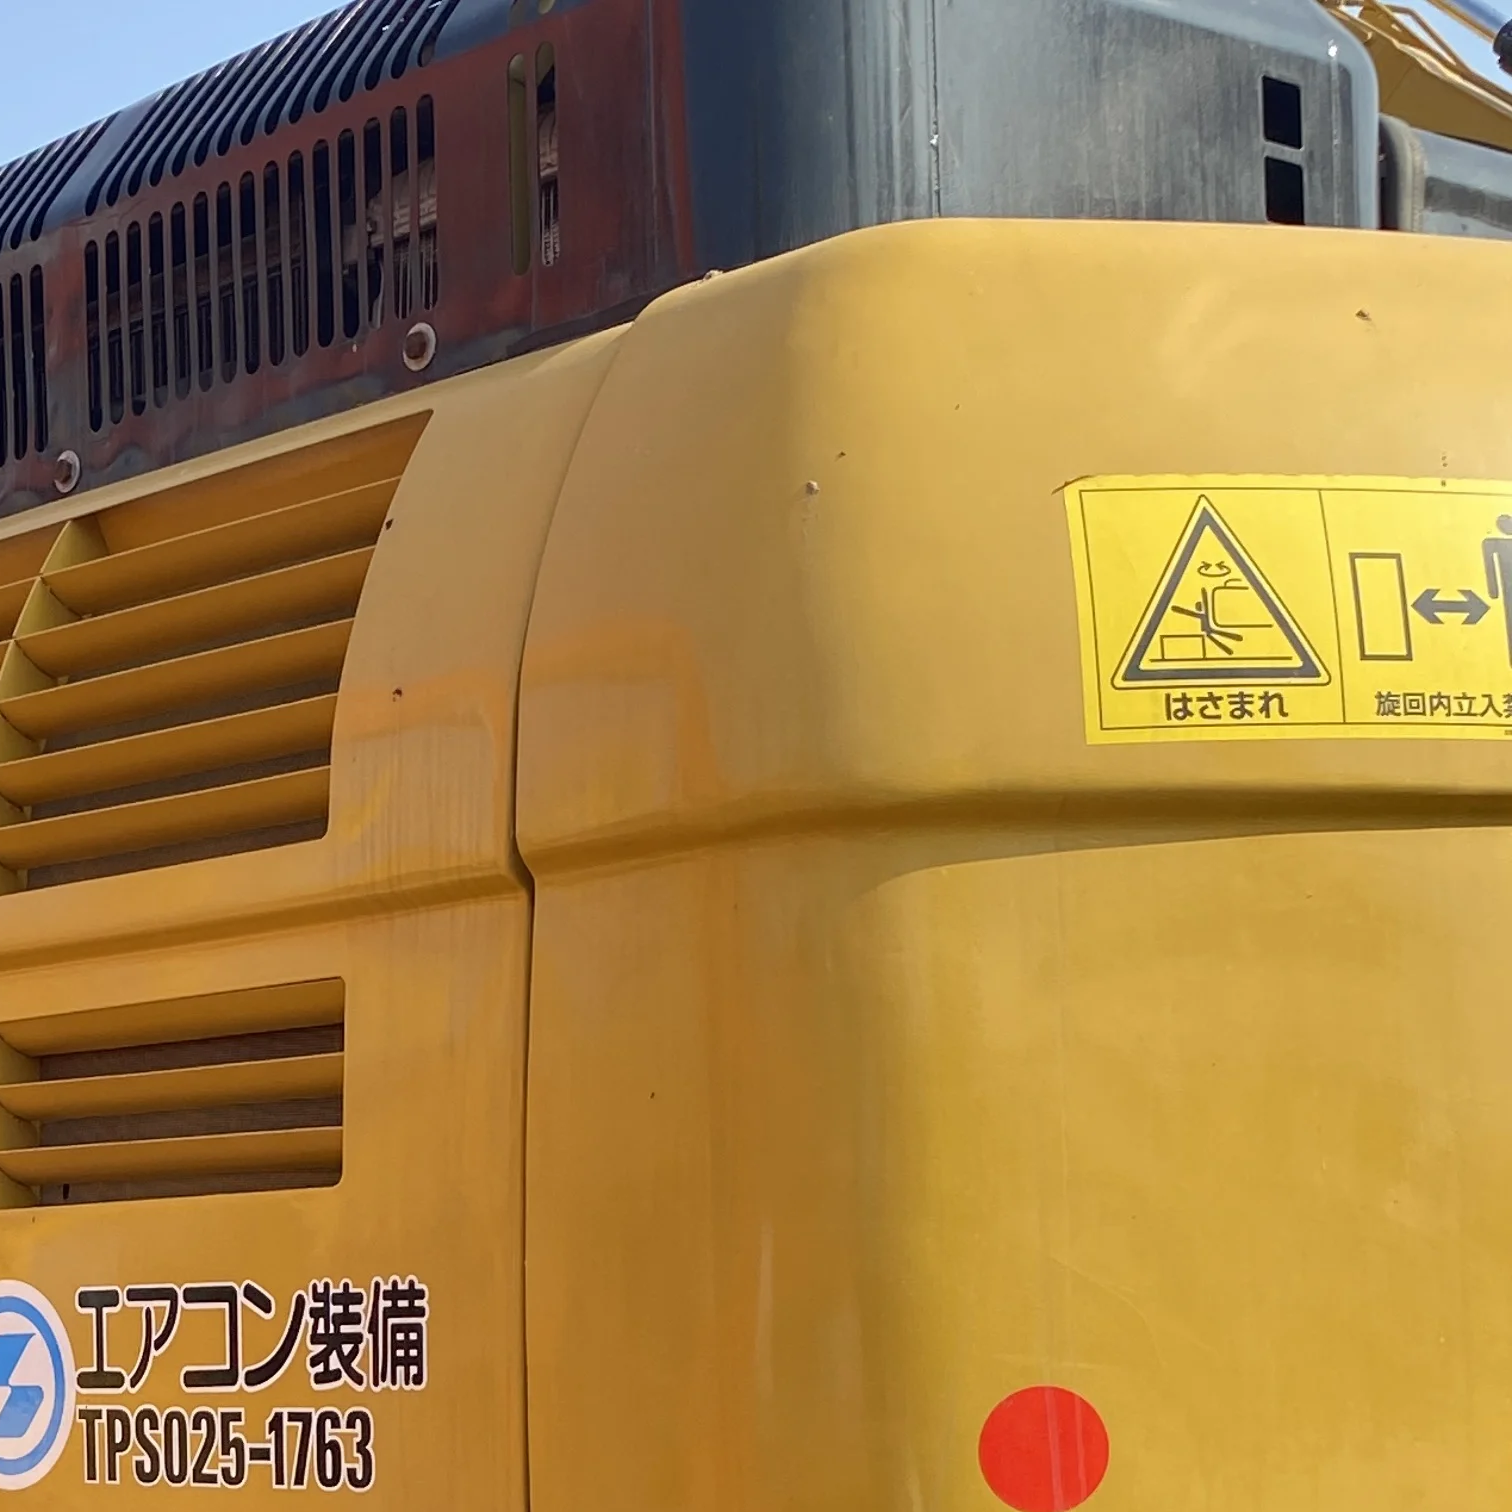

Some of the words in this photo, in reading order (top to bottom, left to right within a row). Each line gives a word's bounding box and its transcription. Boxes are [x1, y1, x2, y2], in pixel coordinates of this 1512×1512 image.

[1164, 690, 1289, 721] はさまれ
[77, 1278, 427, 1389] エアコン装備
[78, 1406, 373, 1490] TPS025-1763
